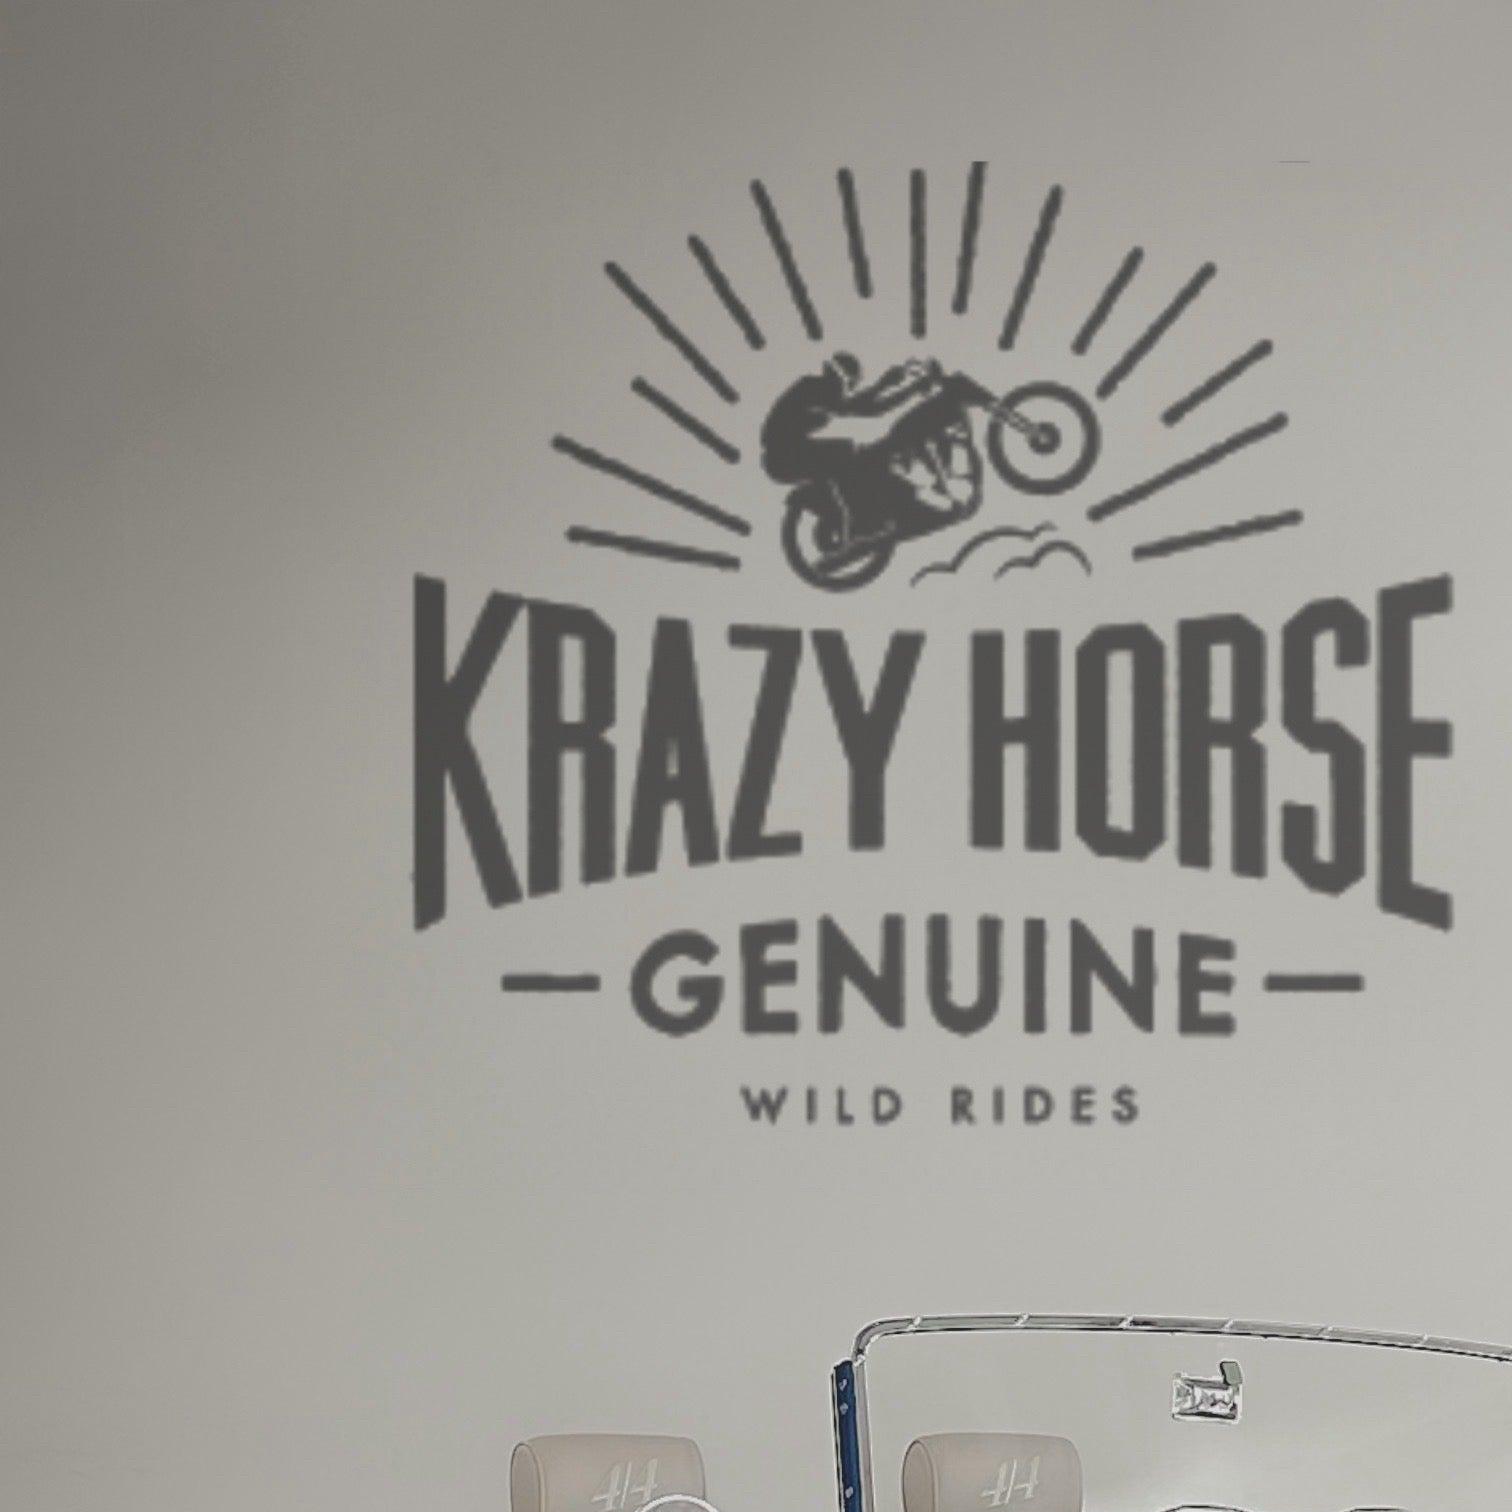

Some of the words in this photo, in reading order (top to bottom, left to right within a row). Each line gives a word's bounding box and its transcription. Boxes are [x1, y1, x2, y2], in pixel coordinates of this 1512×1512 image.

[412, 572, 926, 931] KRAZY
[969, 574, 1453, 931] HORSE
[629, 913, 1236, 1037] GENUINE
[740, 1085, 902, 1125] WILD
[950, 1085, 1139, 1125] RIDES
